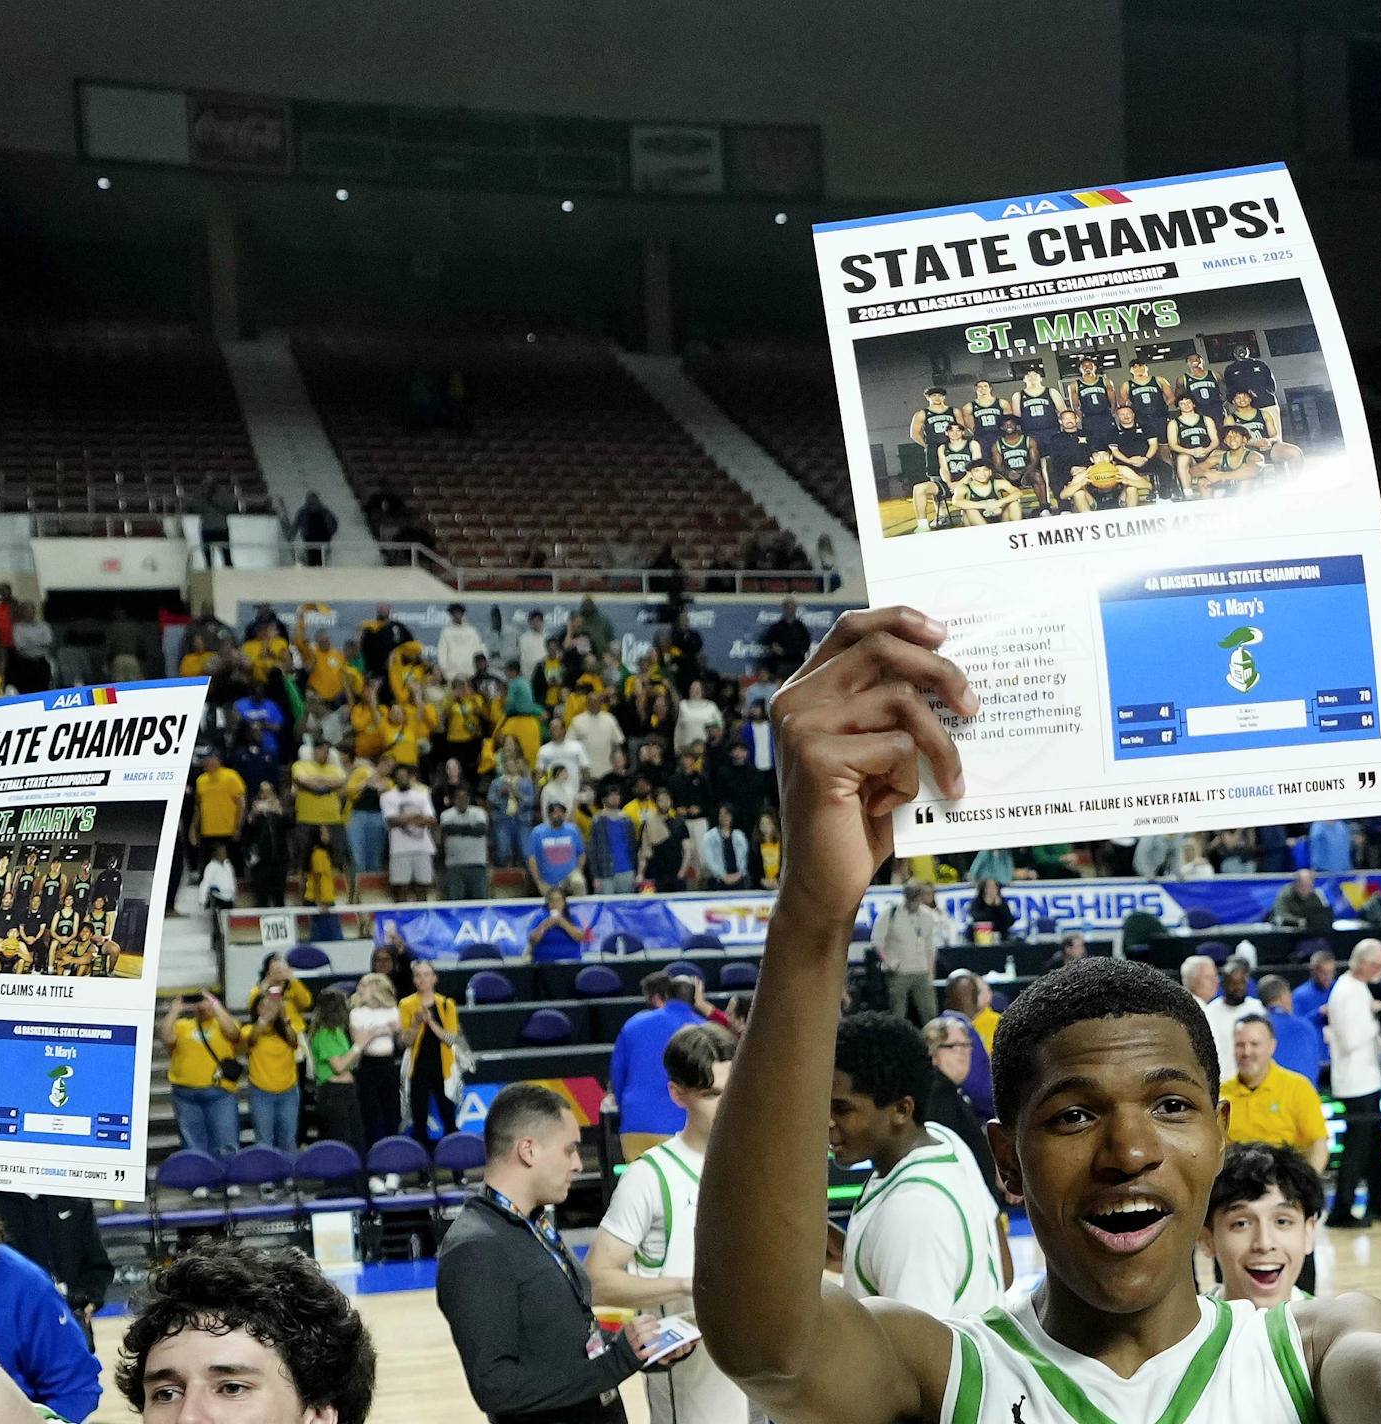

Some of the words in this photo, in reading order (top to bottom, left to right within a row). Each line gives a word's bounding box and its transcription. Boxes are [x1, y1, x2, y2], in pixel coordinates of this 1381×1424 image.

[1002, 200, 1059, 218] AIA
[840, 232, 1016, 294] STATE
[1027, 196, 1286, 268] CHAMPS!
[1202, 255, 1247, 270] MARCH
[1248, 254, 1260, 263] 6,
[1262, 249, 1293, 262] 2025
[857, 303, 896, 320] 2025
[897, 300, 918, 317] 4A
[917, 287, 1010, 314] BASKETBALL
[1009, 280, 1057, 301] STATE
[1056, 265, 1167, 295] CHAMPIONSHIP
[965, 322, 1026, 354] ST.
[1035, 300, 1181, 345] MARY'S
[986, 345, 1036, 359] BOYS
[1040, 328, 1160, 352] BASKETBALL
[1009, 533, 1034, 550] ST.
[1037, 524, 1101, 546] MARY'S
[1105, 517, 1168, 539] CLAIMS
[1145, 578, 1159, 592] 4A
[1159, 571, 1228, 590] BASKETBALL
[1228, 569, 1262, 586] STATE
[1264, 565, 1321, 583] CHAMPION
[1207, 599, 1224, 617] St.
[1224, 596, 1264, 618] Mary's
[52, 693, 82, 709] AIA
[47, 714, 188, 762] CHAMPS!
[19, 805, 97, 836] MARY'S
[262, 919, 289, 943] 205
[454, 918, 518, 946] AIA
[0, 983, 34, 997] CLAIMS
[35, 985, 47, 997] 4A
[49, 985, 74, 998] TITLE
